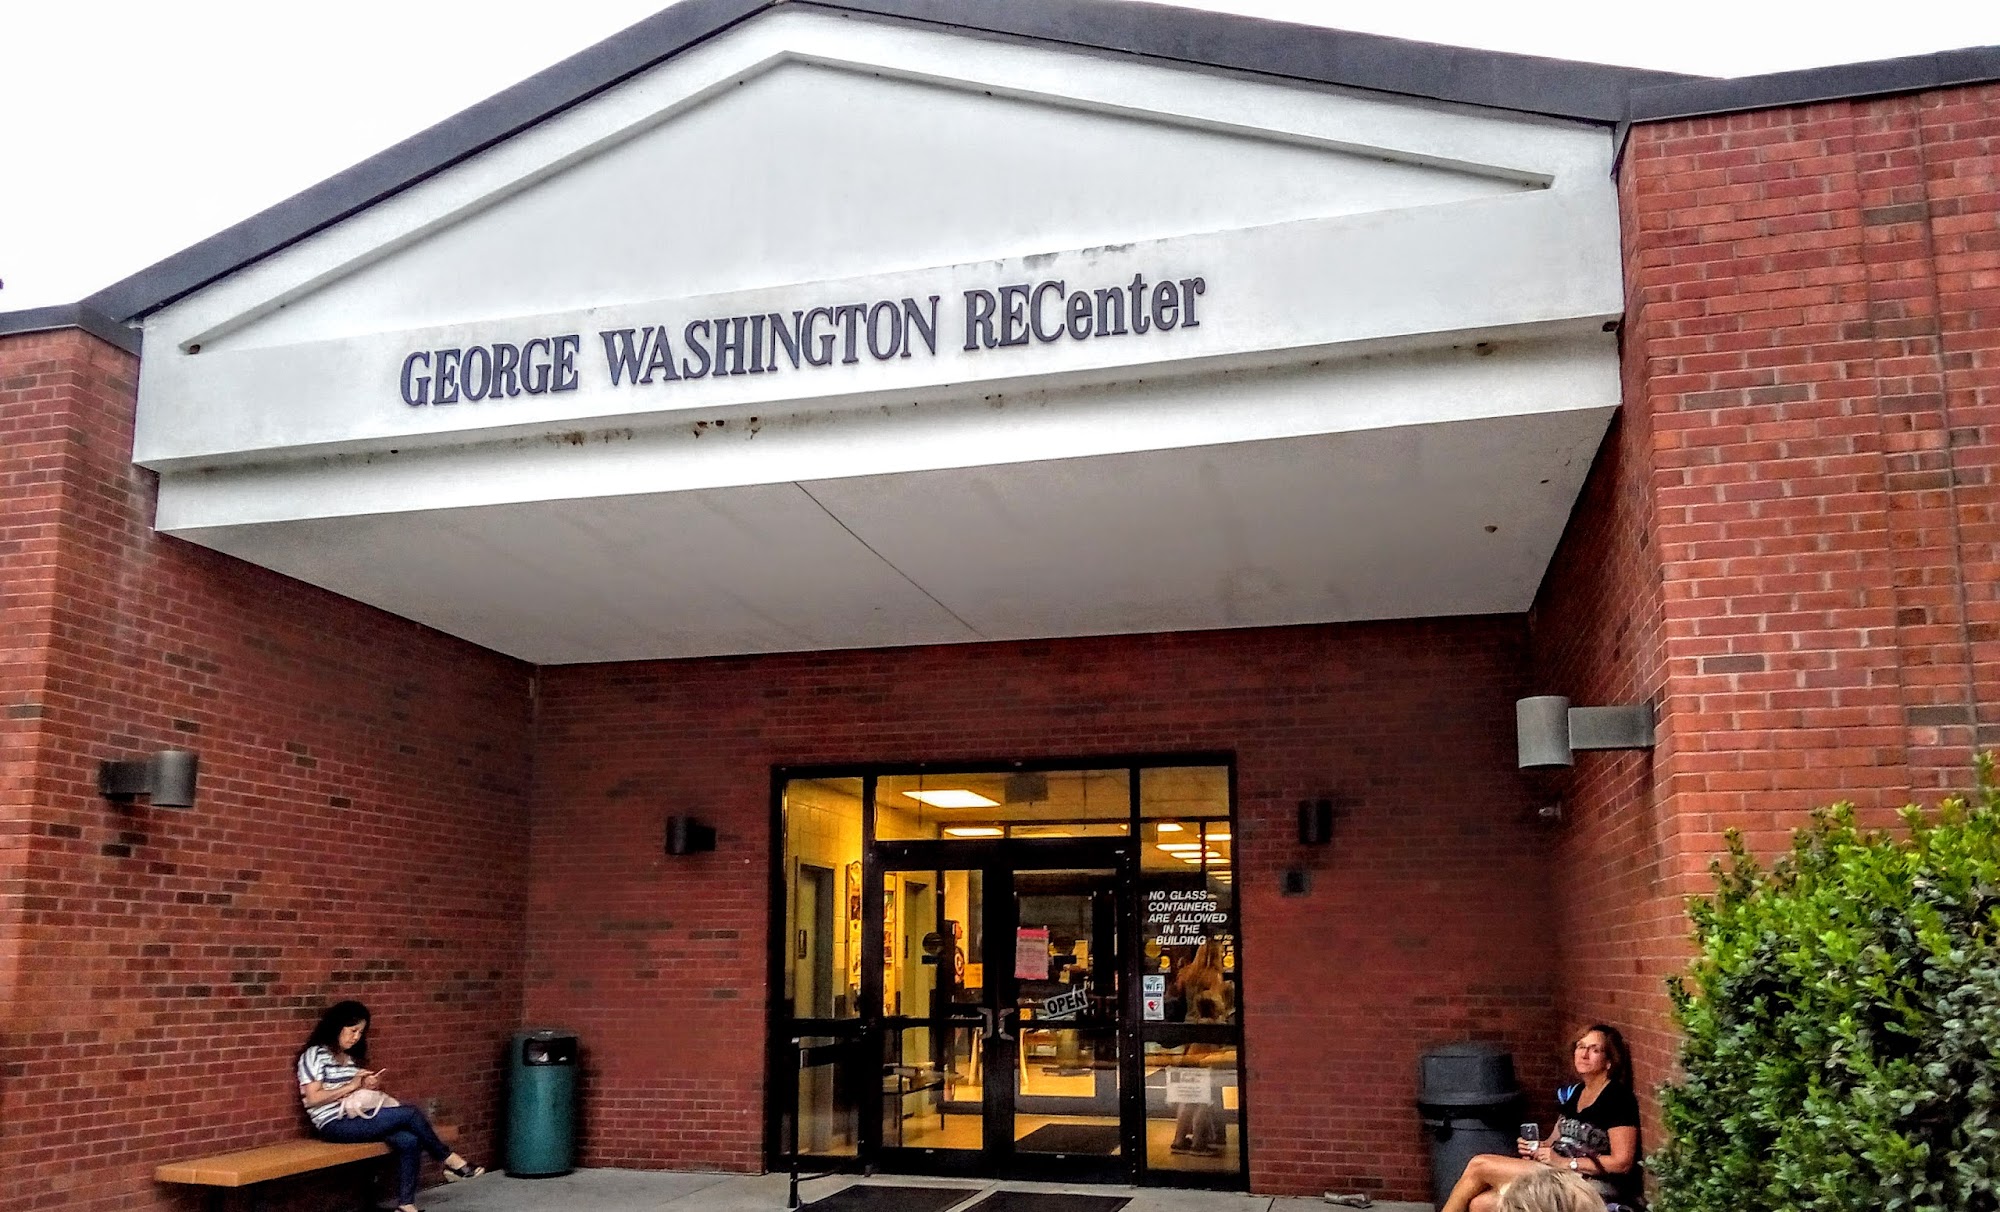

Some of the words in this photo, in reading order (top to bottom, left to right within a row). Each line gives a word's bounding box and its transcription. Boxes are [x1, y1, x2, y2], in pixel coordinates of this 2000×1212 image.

[399, 334, 580, 407] GEORGE
[599, 295, 939, 387] WASHINGTON
[963, 273, 1206, 351] RECenter
[1148, 890, 1166, 900] NO
[1169, 890, 1207, 900] GLASS
[1148, 901, 1217, 912] CONTAINERS
[1148, 913, 1171, 923] ARE
[1174, 913, 1228, 923] ALLOWED
[1162, 924, 1175, 934] IN
[1179, 924, 1200, 934] THE
[1155, 935, 1207, 946] BUILDING
[1047, 991, 1087, 1014] OPEN
